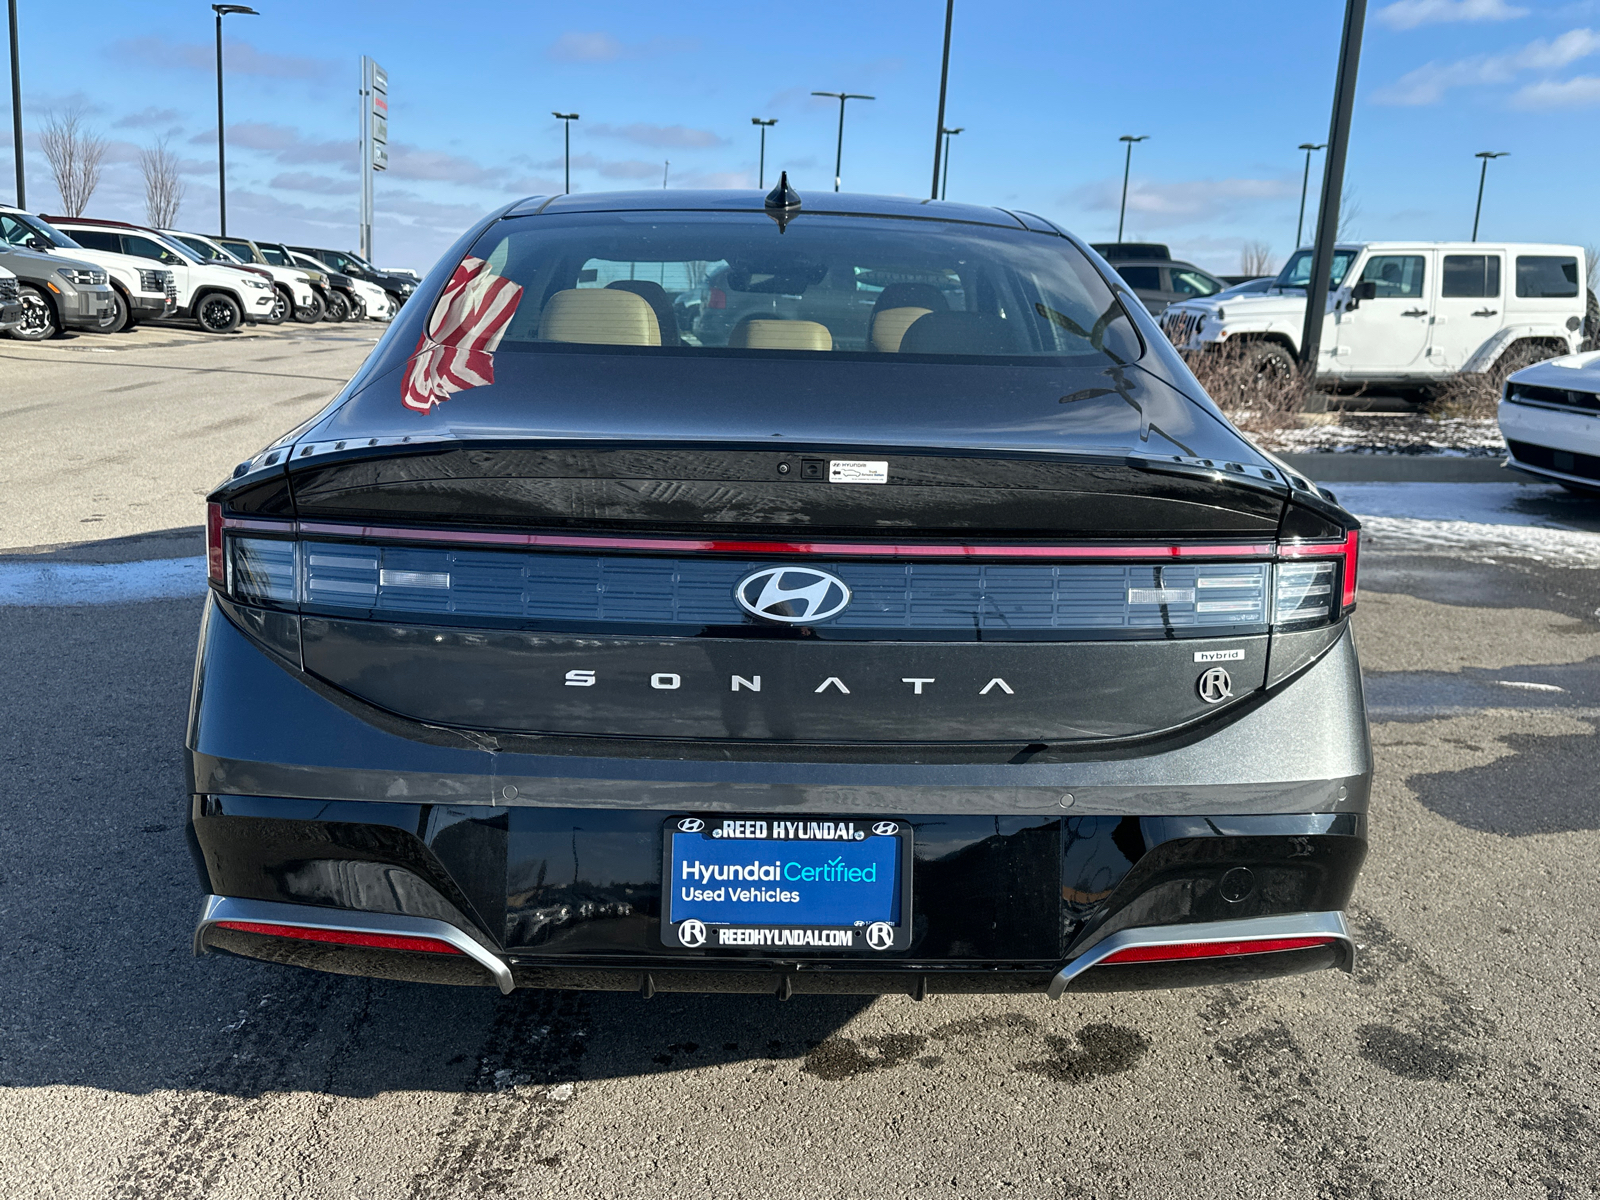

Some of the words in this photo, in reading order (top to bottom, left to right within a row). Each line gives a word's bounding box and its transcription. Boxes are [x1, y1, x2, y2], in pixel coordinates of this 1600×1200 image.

[1201, 651, 1239, 660] hybrid
[564, 669, 1015, 695] SONATA
[1201, 668, 1233, 700] R
[722, 820, 767, 839] REED
[772, 821, 855, 840] HYUNDAI
[682, 861, 781, 884] Hyundai
[783, 856, 877, 882] Certified
[681, 887, 725, 902] Used
[728, 887, 800, 903] Vehicles
[679, 919, 706, 947] R
[719, 928, 852, 946] REEDHYUNDAI.COM
[867, 921, 893, 949] R
